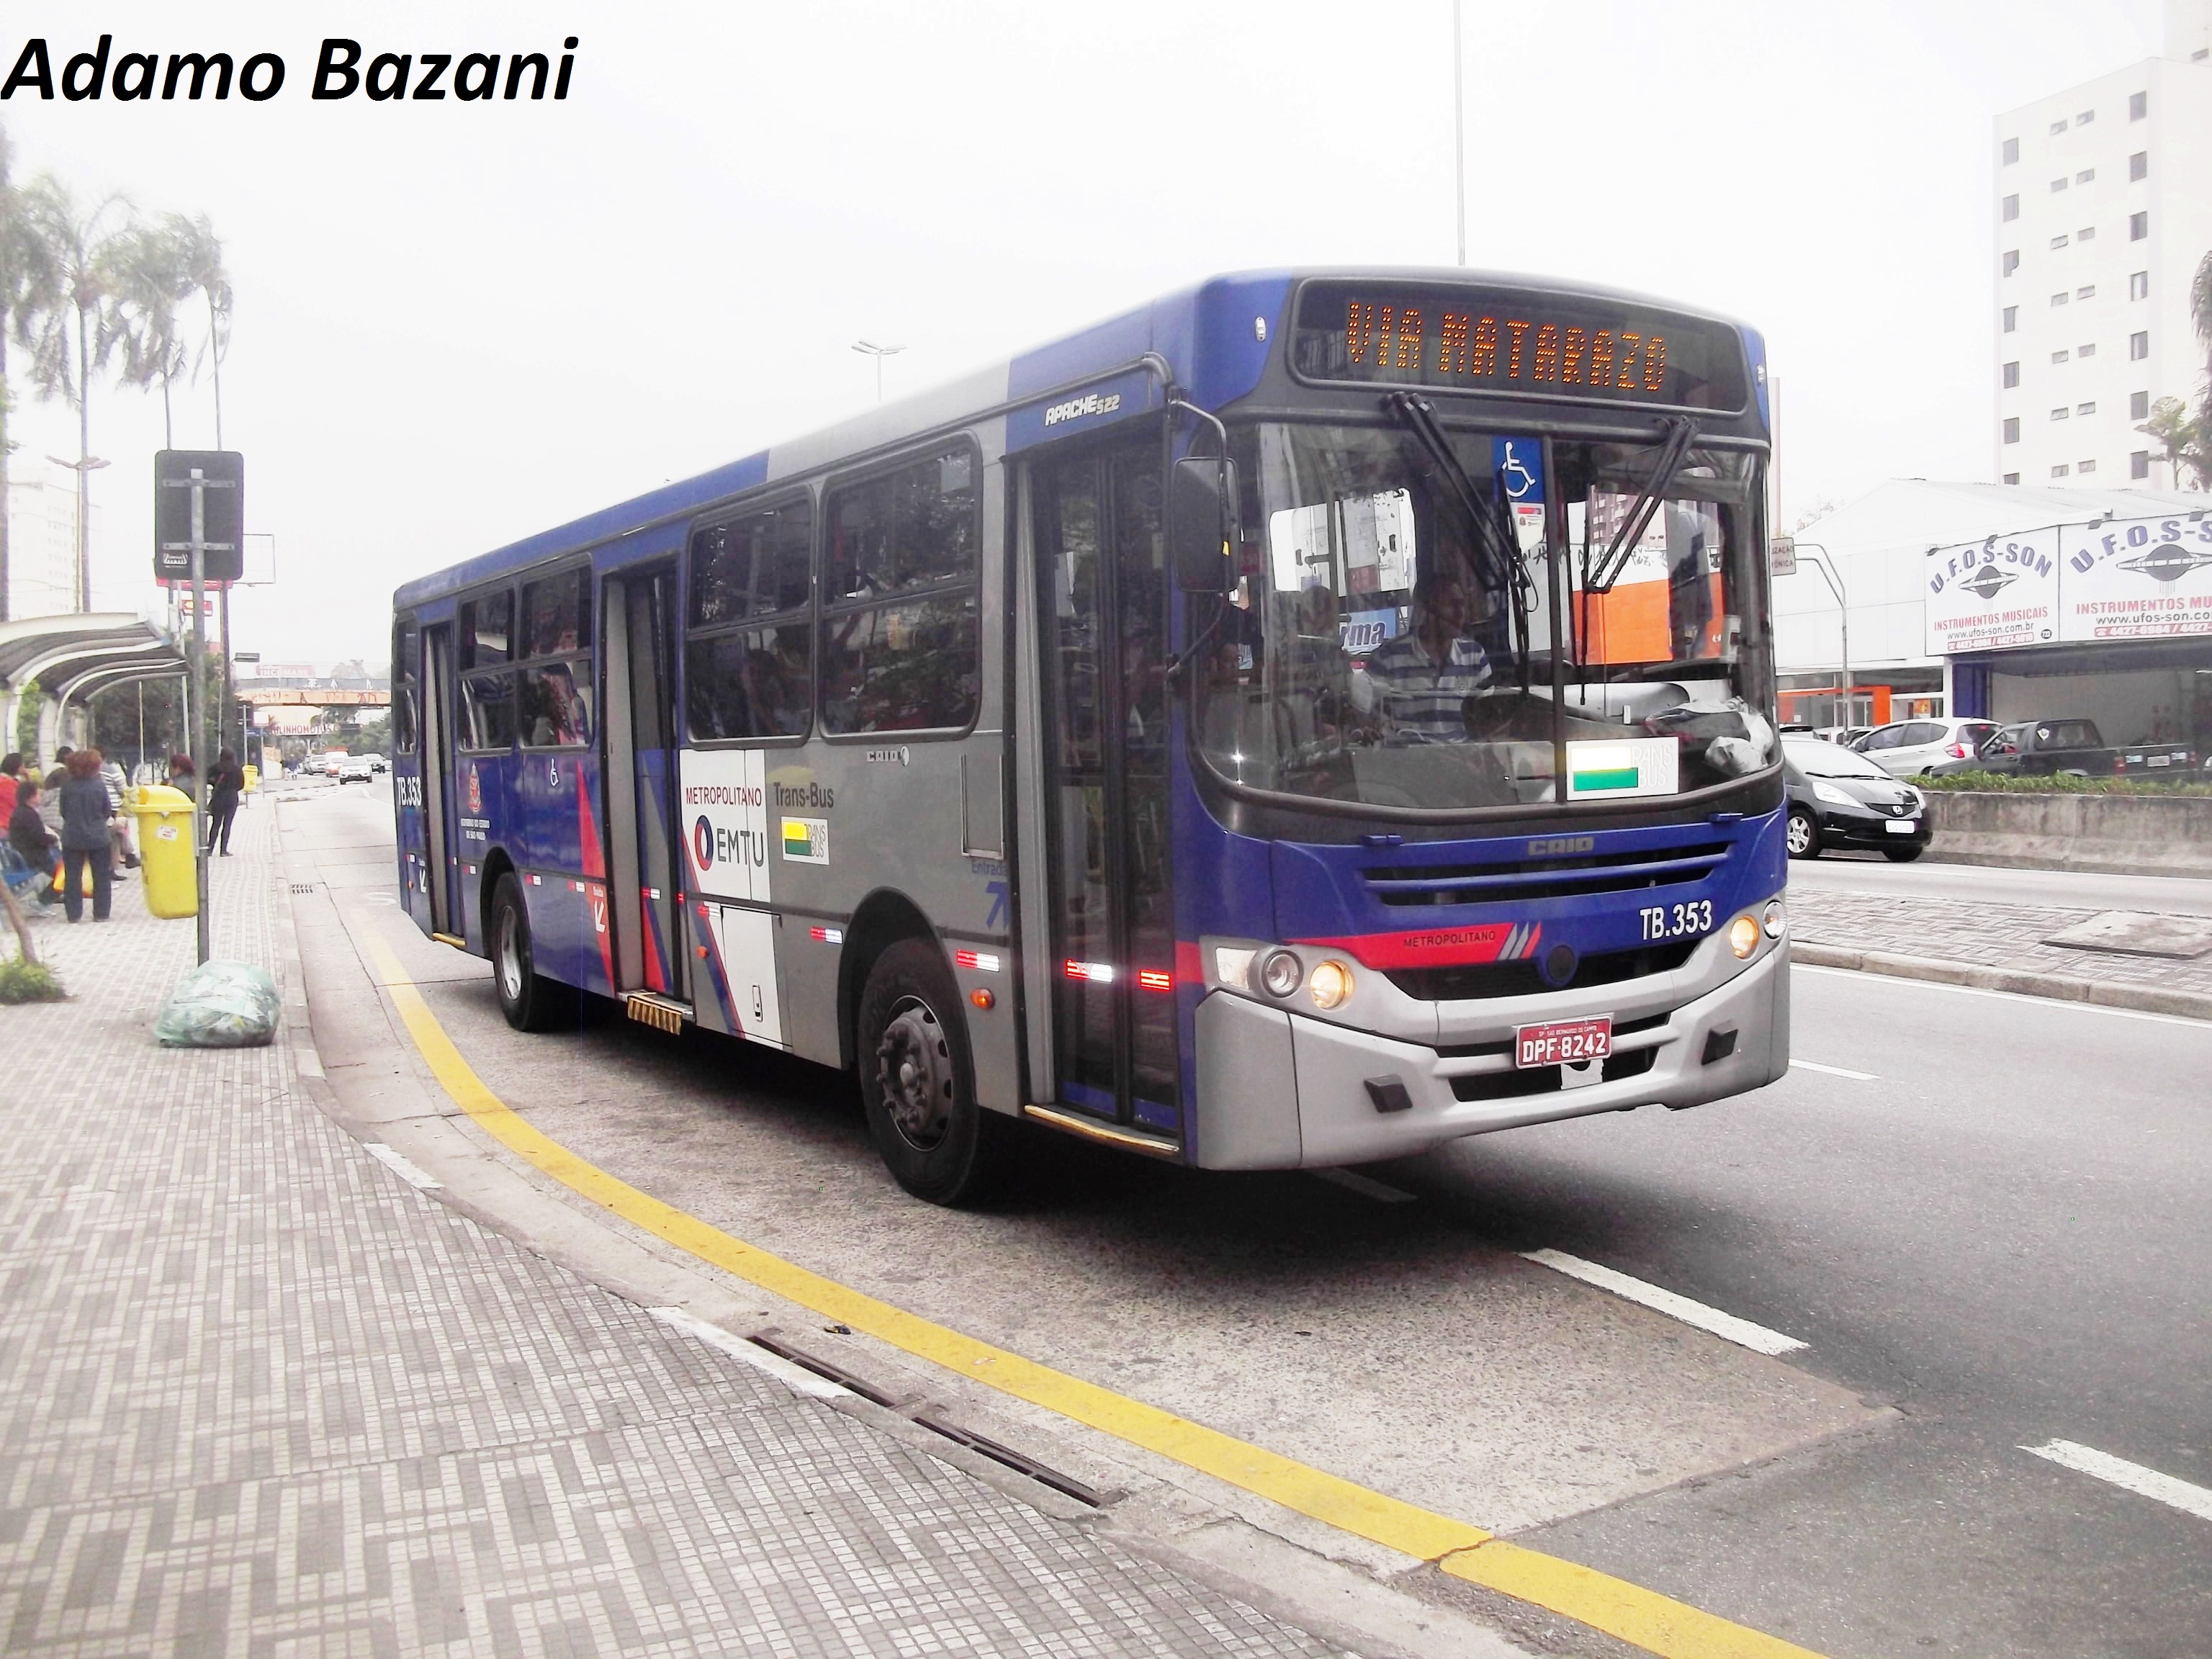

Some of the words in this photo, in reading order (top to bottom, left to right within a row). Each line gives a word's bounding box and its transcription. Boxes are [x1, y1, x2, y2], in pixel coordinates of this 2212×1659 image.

[1347, 301, 1422, 369] VIA
[1439, 313, 1667, 391] MATARAZO
[1044, 393, 1098, 426] APACHE
[2076, 597, 2185, 615] INSTRUMENTOS
[2096, 611, 2212, 625] www.ufos-son.co
[1934, 613, 2000, 631] INSTRUMENTOS
[2002, 606, 2049, 623] MUSICAIS
[1946, 621, 2035, 640] www.ufos-son.com.br
[866, 750, 900, 763] CAIO
[1639, 765, 1668, 789] BUS
[396, 775, 422, 807] TB.353
[685, 786, 763, 807] METROPOLITANO
[773, 781, 835, 809] Trans-Bus
[716, 827, 765, 868] EMTU
[1527, 837, 1594, 856] CAIO
[1639, 899, 1712, 940] TB.353
[1403, 930, 1496, 948] METROPOLITANO
